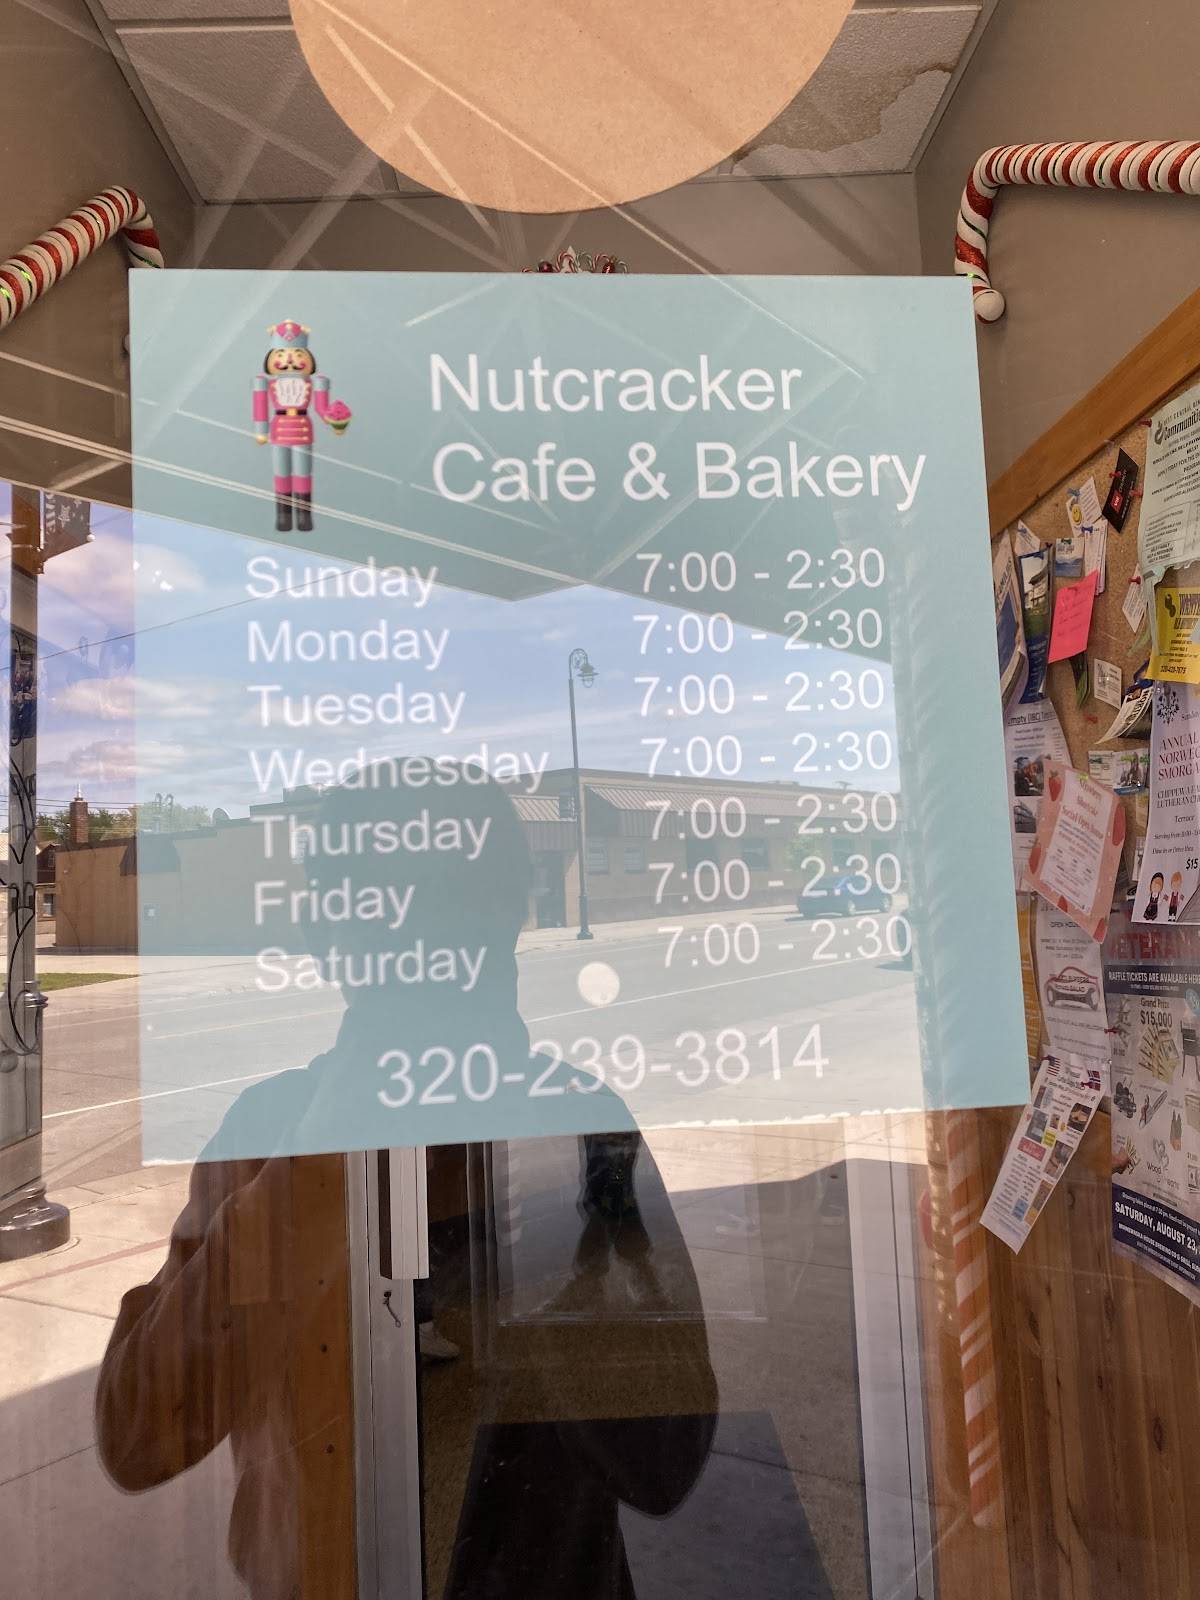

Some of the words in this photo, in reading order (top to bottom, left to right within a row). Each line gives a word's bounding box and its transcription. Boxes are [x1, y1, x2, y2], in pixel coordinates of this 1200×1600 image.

[428, 353, 803, 414] Nutcracker
[431, 441, 597, 504] Cafe
[622, 441, 671, 502] &
[696, 440, 928, 512] Bakery
[245, 554, 438, 608] Sunday
[636, 550, 737, 594] 7:00
[785, 547, 886, 590] 2:30
[247, 619, 451, 671] Monday
[632, 612, 734, 655] 7:00
[783, 608, 884, 652] 2:30
[247, 681, 466, 734] Tuesday
[633, 674, 735, 717] 7:00
[784, 669, 885, 713] 2:30
[249, 743, 550, 794] Wednesday
[640, 735, 742, 779] 7:00
[791, 729, 893, 774] 2:30
[1159, 761, 1200, 780] SMORGA
[251, 808, 492, 861] Thursday
[646, 797, 748, 842] 7:00
[796, 792, 898, 837] 2:30
[253, 878, 416, 928] Friday
[648, 858, 751, 904] 7:00
[800, 853, 903, 898] 2:30
[254, 939, 488, 994] Saturday
[657, 922, 761, 968] 7:00
[810, 915, 912, 961] 2:30
[1109, 971, 1126, 981] RAFFLE
[1127, 972, 1147, 982] TICKETS
[1148, 973, 1160, 982] ARE
[1160, 973, 1188, 984] AVAILABLE
[1140, 998, 1156, 1008] Grand
[1140, 1010, 1173, 1028] $15,000
[376, 1022, 830, 1109] 320-239-3814
[1114, 1201, 1156, 1232] SATURDAY,
[1156, 1220, 1186, 1245] AUGUST
